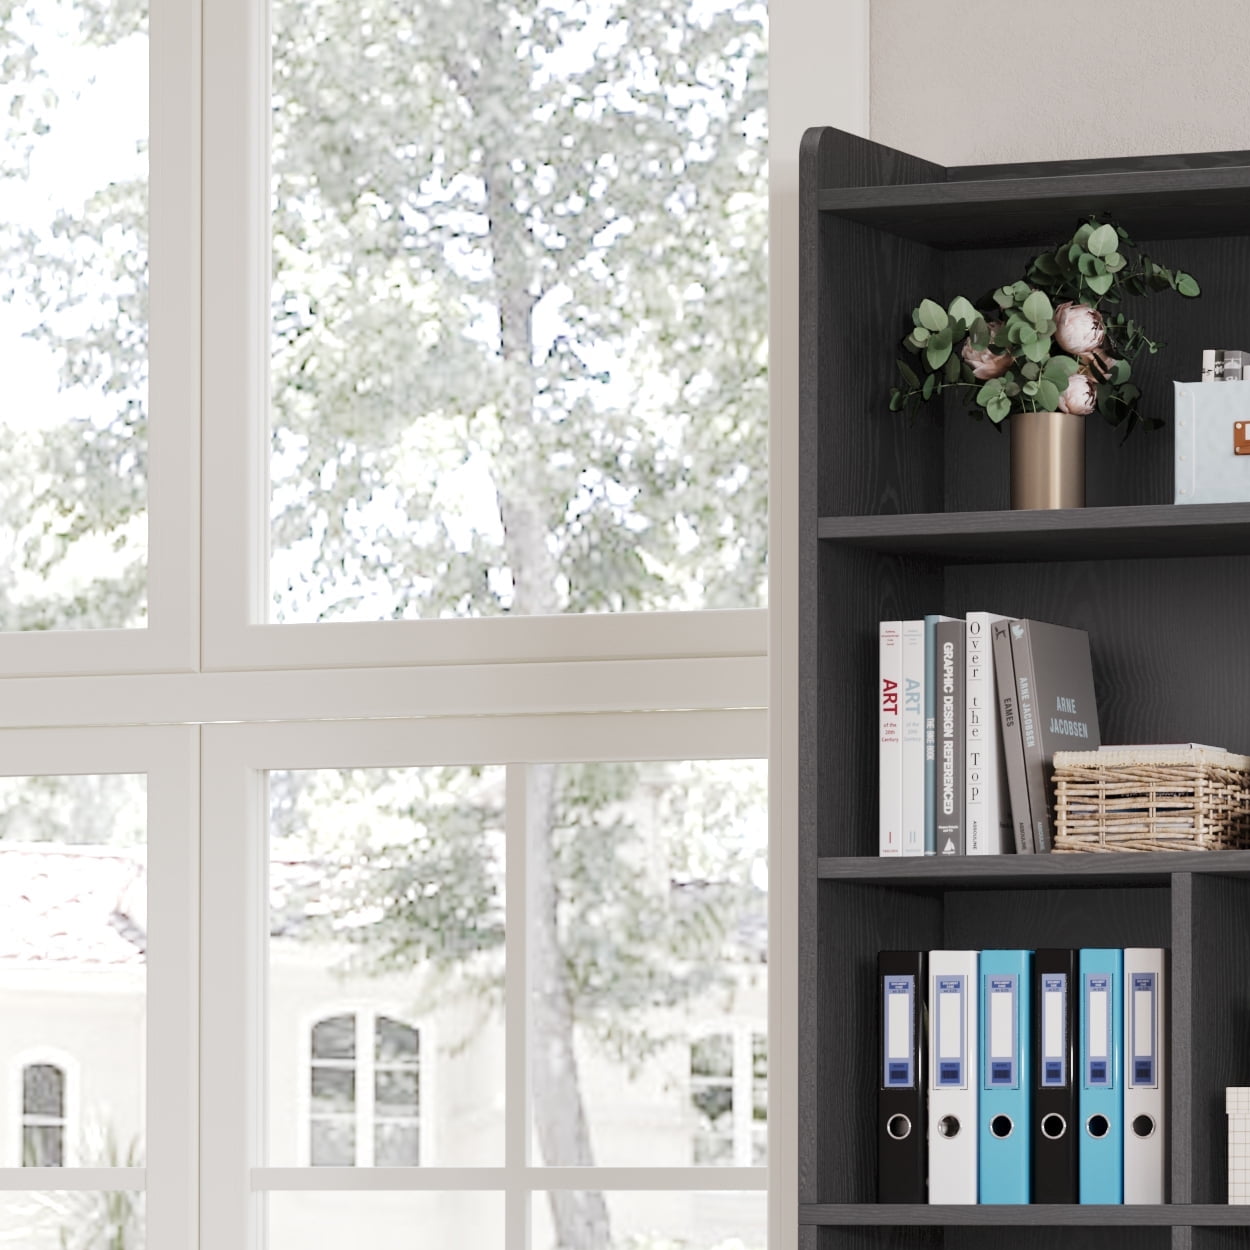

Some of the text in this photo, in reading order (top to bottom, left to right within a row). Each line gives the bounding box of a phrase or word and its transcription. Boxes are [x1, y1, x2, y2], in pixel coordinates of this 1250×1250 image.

[943, 641, 954, 693] GRAPHIC
[882, 678, 898, 715] ART
[905, 678, 921, 714] ART
[970, 621, 981, 801] Over the Top
[1003, 697, 1014, 728] EAMES
[1019, 677, 1036, 748] ARNE JACOBSEN
[1056, 696, 1076, 714] ARNE
[943, 696, 954, 738] DESIGN
[1050, 718, 1088, 739] JACOBSEN
[943, 740, 954, 815] REFERENCED
